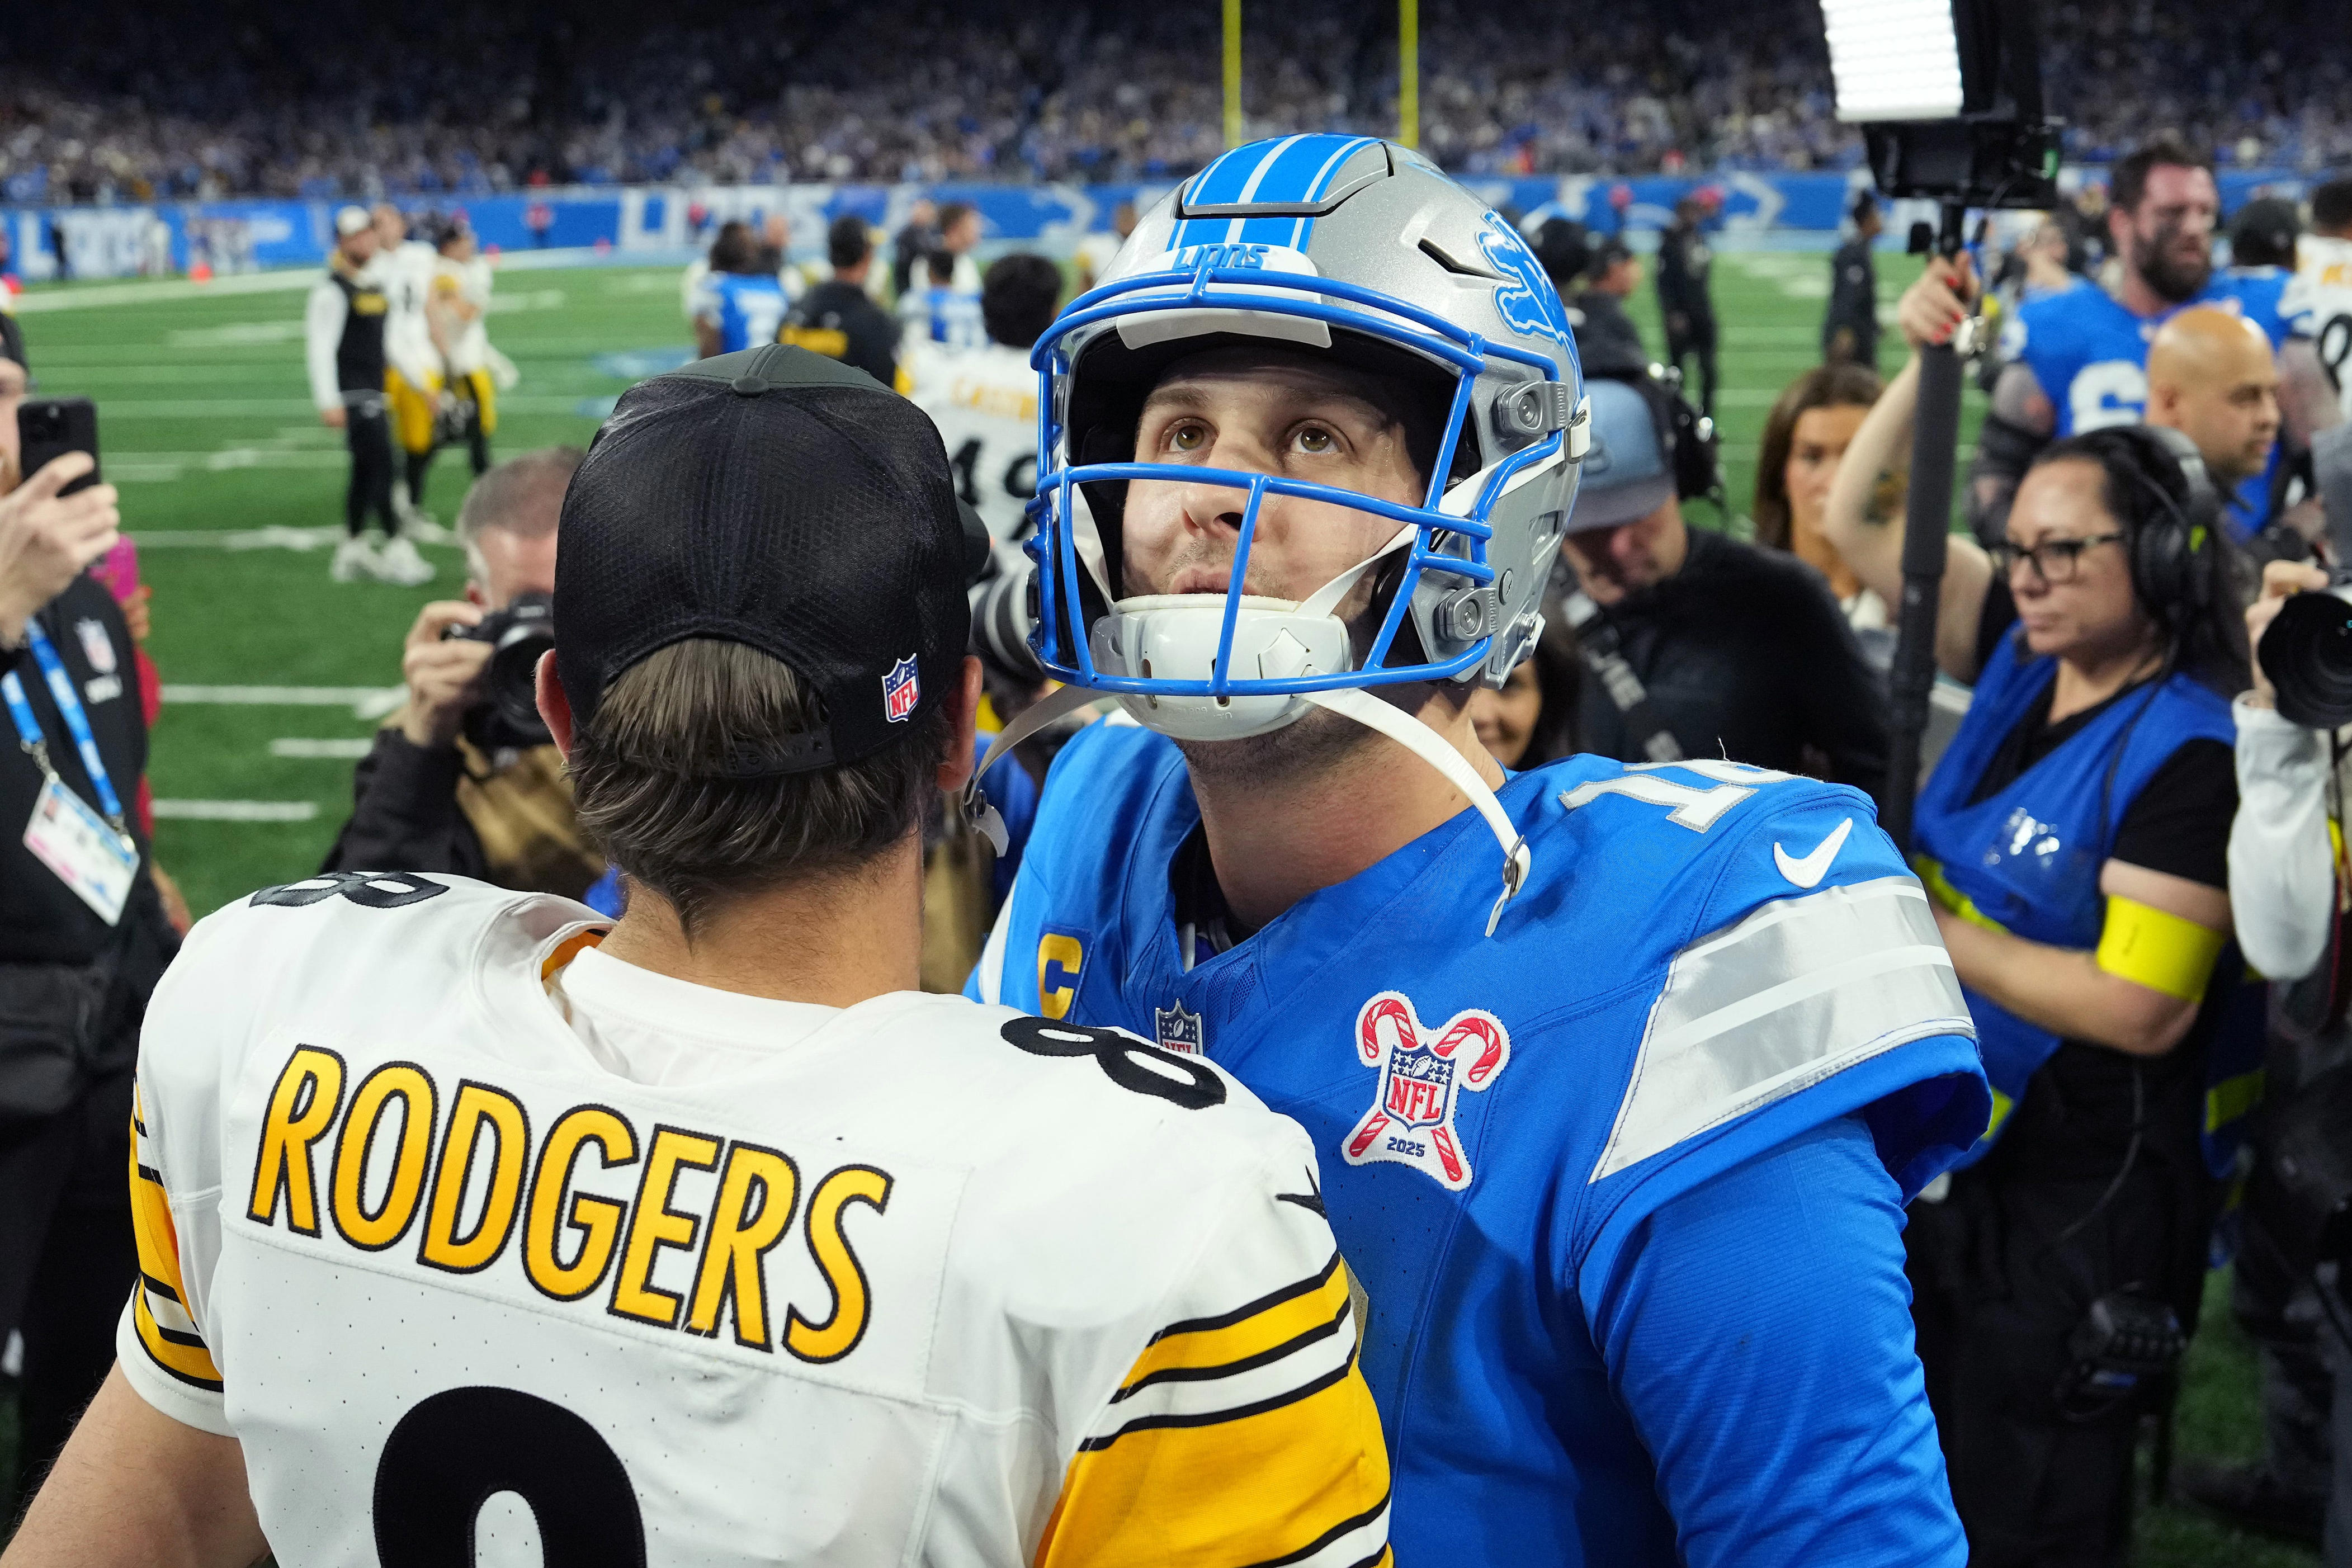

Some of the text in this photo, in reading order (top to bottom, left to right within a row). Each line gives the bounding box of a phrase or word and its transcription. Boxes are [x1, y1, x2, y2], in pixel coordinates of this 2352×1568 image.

[1172, 244, 1270, 270] LIONS
[890, 681, 918, 716] NFL
[249, 870, 451, 909] 8
[1037, 933, 1083, 1021] C
[1000, 1016, 1227, 1110] 8
[1387, 1076, 1441, 1122] NFL
[1386, 1136, 1425, 1157] 2025
[247, 1043, 895, 1364] RODGERS
